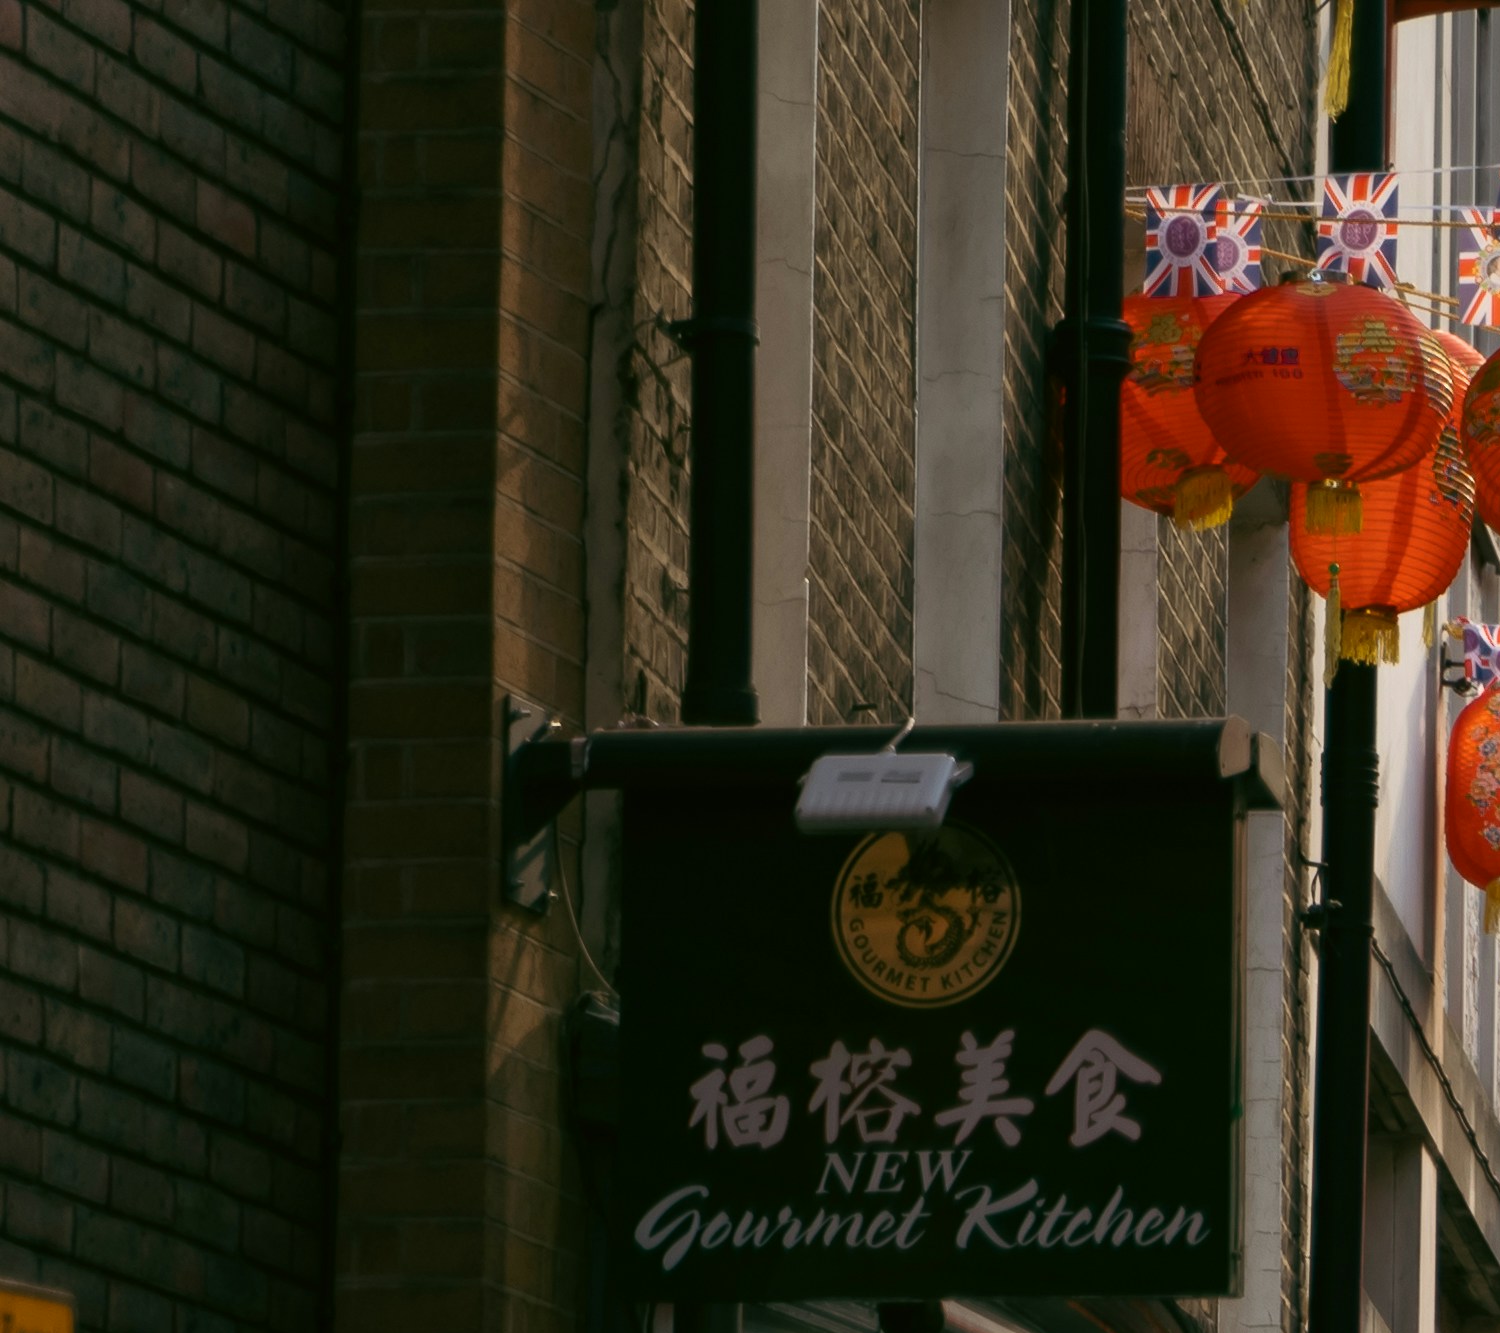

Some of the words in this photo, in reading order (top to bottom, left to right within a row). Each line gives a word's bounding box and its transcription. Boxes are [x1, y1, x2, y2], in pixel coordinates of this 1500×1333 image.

[849, 917, 931, 993] GOURMET
[940, 909, 1008, 991] KITCHEN
[688, 1026, 1164, 1151] 福榕美食
[815, 1149, 974, 1197] NEW
[633, 1181, 934, 1273] Gourmet
[953, 1176, 1213, 1251] Kitchen
